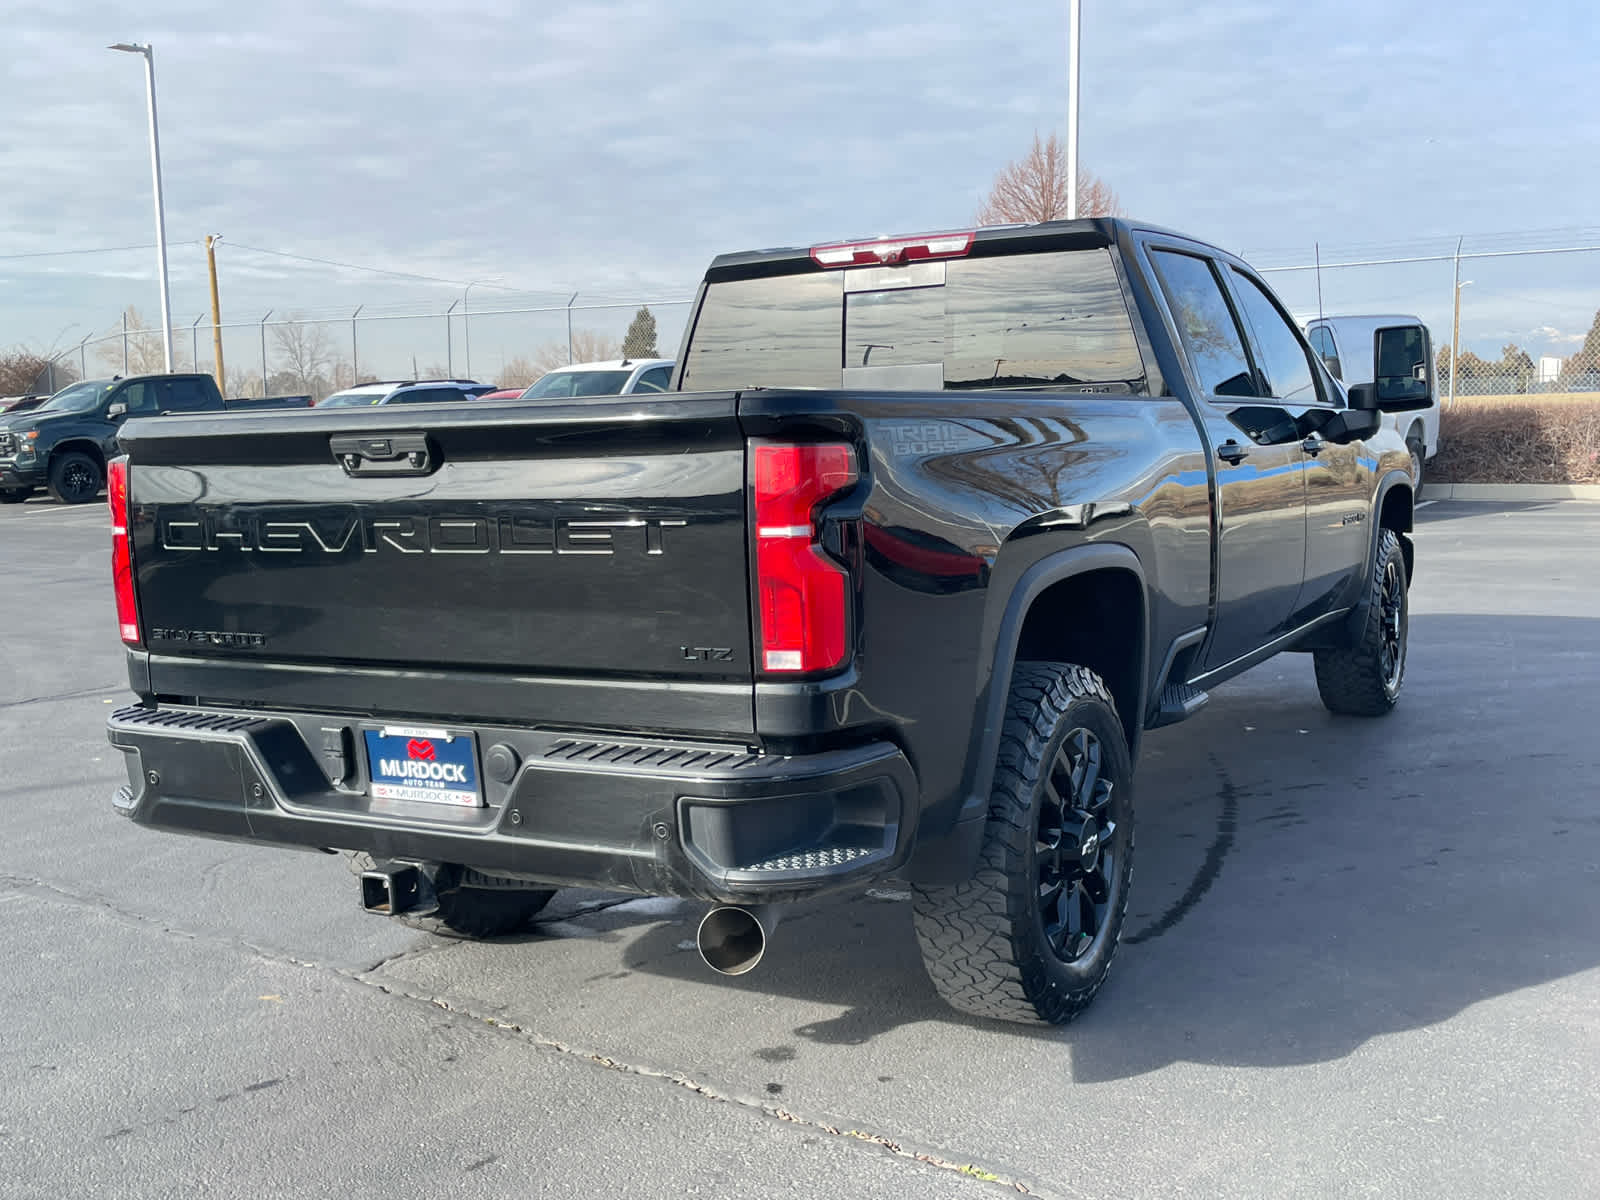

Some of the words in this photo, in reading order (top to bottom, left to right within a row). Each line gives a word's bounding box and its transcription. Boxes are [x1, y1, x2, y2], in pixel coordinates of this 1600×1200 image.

[876, 424, 967, 440] TRAIL
[894, 440, 960, 456] BOSS
[160, 515, 688, 555] CHEVROLET
[680, 646, 733, 661] LTZ
[380, 759, 467, 782] MURDOCK
[425, 780, 445, 788] TEAM
[396, 788, 452, 801] MURDOCK
